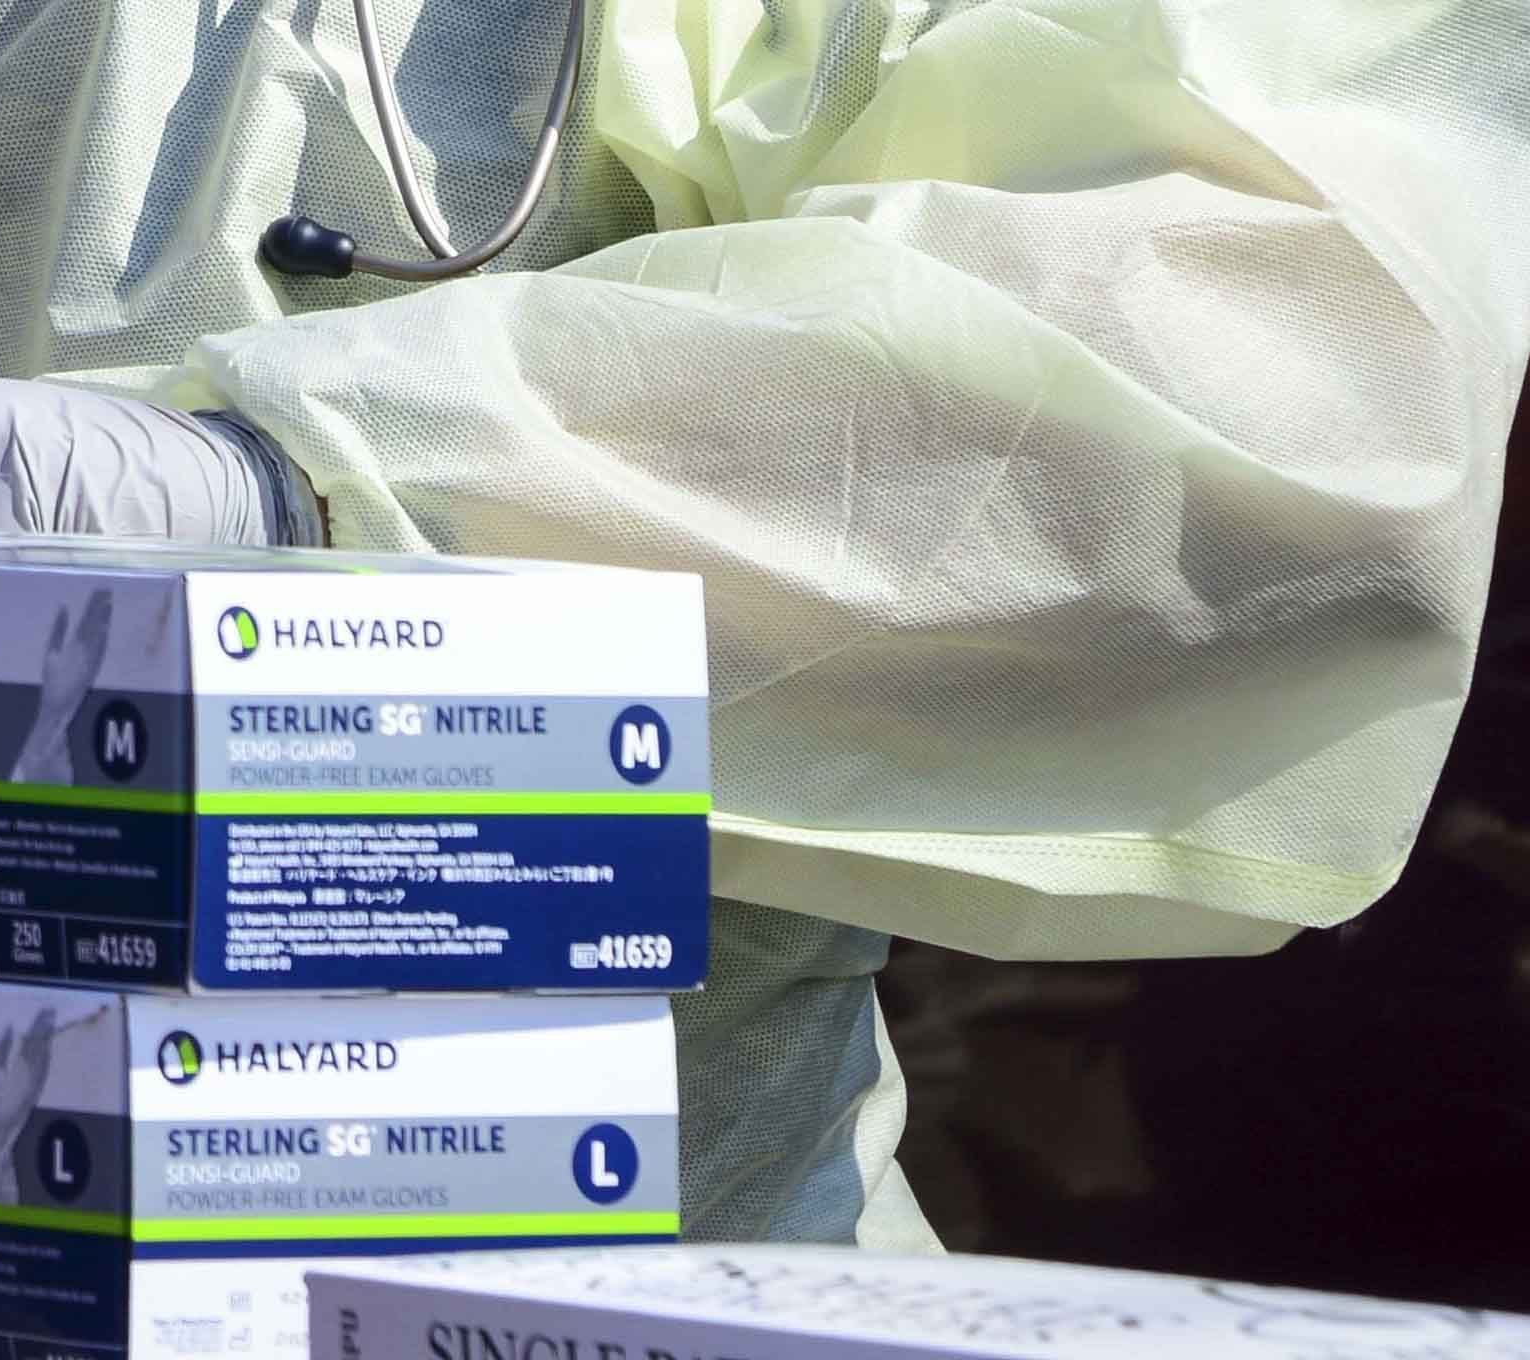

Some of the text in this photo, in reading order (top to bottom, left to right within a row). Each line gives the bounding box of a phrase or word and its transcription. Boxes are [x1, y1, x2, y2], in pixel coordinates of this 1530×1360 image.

[273, 618, 445, 649] HALYARD
[228, 705, 374, 734] STERLING
[435, 705, 547, 734] NITRILE
[105, 719, 136, 764] M
[227, 740, 356, 762] SENSI-GUARD
[621, 722, 662, 770] M
[229, 767, 496, 787] POWDER-FREE EXAM GLOVES
[13, 921, 43, 948] 250
[97, 932, 157, 969] 41659
[598, 934, 673, 969] 41659
[217, 1040, 399, 1073] HALYARD
[168, 1126, 320, 1157] STERLING
[386, 1124, 506, 1155] NITRILE
[54, 1138, 74, 1182] L
[165, 1163, 302, 1186] SENSI-GUARD
[590, 1139, 620, 1188] L
[166, 1186, 449, 1211] POWDER-FREE EXAM GLOVES
